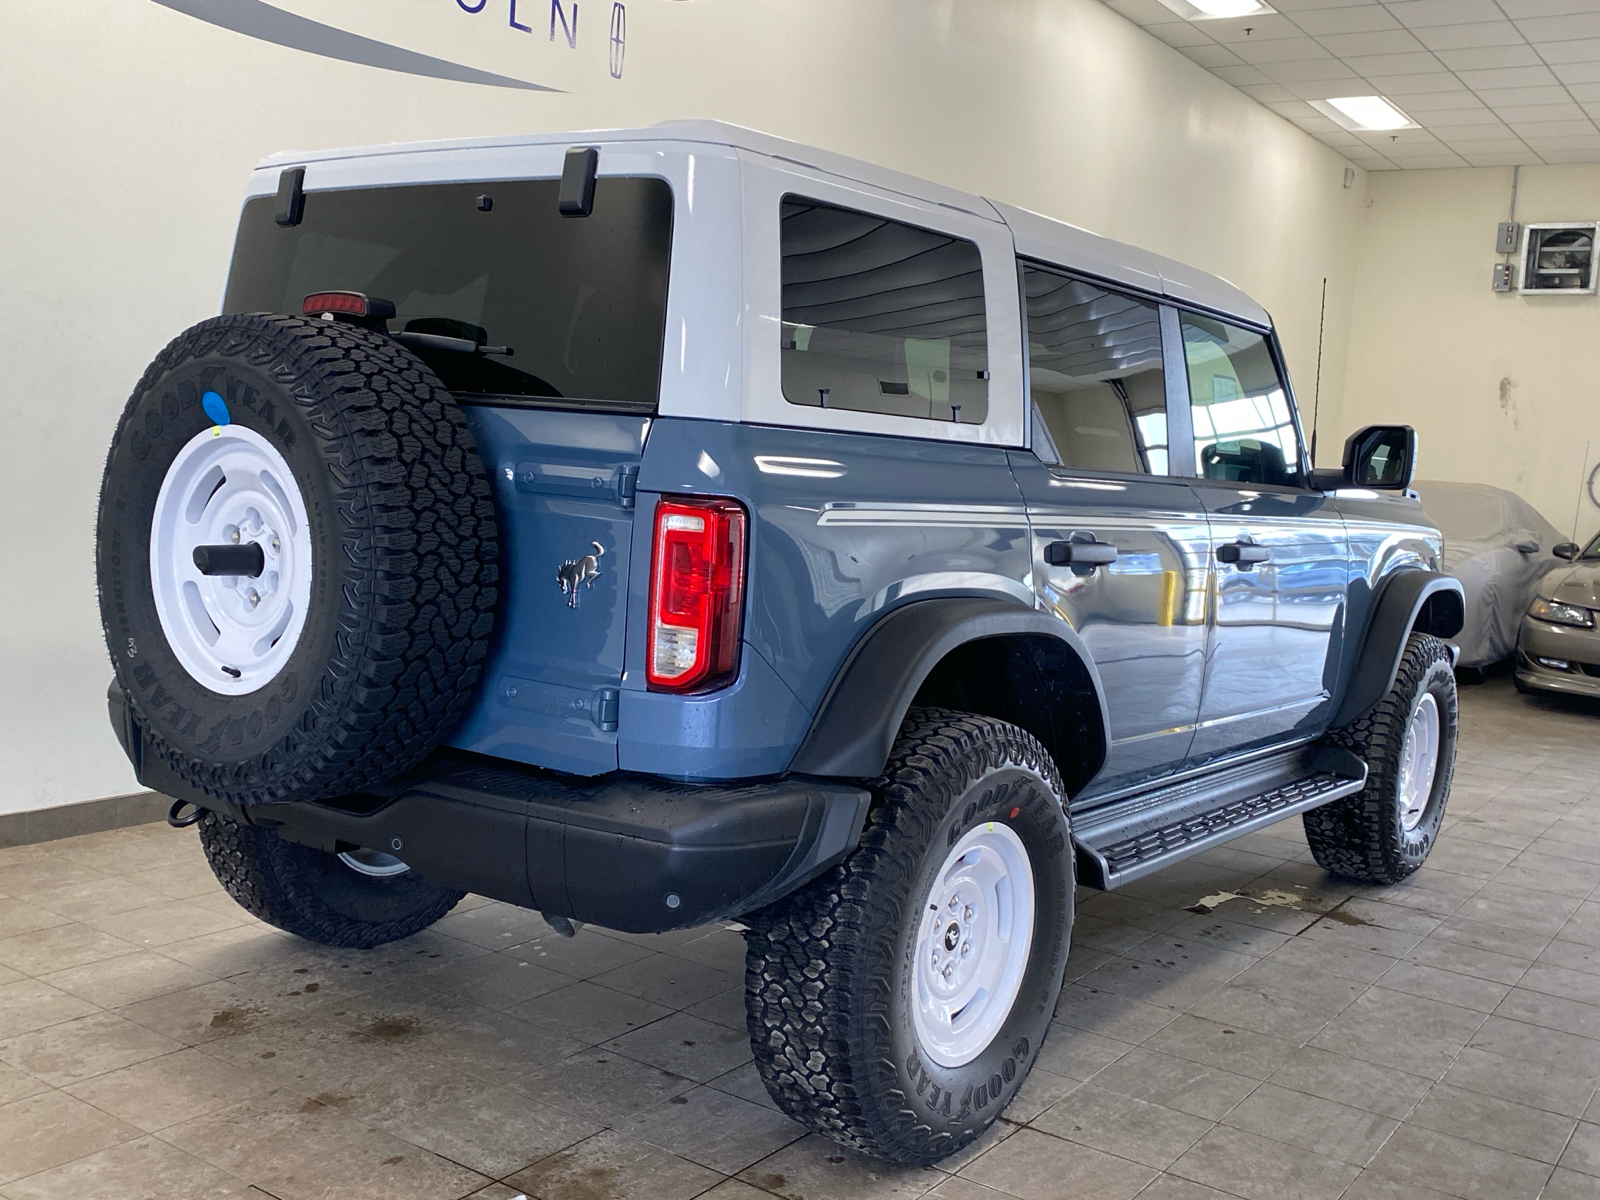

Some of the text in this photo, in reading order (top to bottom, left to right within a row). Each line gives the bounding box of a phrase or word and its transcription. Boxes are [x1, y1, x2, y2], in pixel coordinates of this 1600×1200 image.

[130, 366, 297, 461] GOODYEAR
[133, 659, 299, 754] GOODYEAR
[946, 775, 1064, 858] GOODYEAR
[906, 1036, 1030, 1122] GOODYEAR
